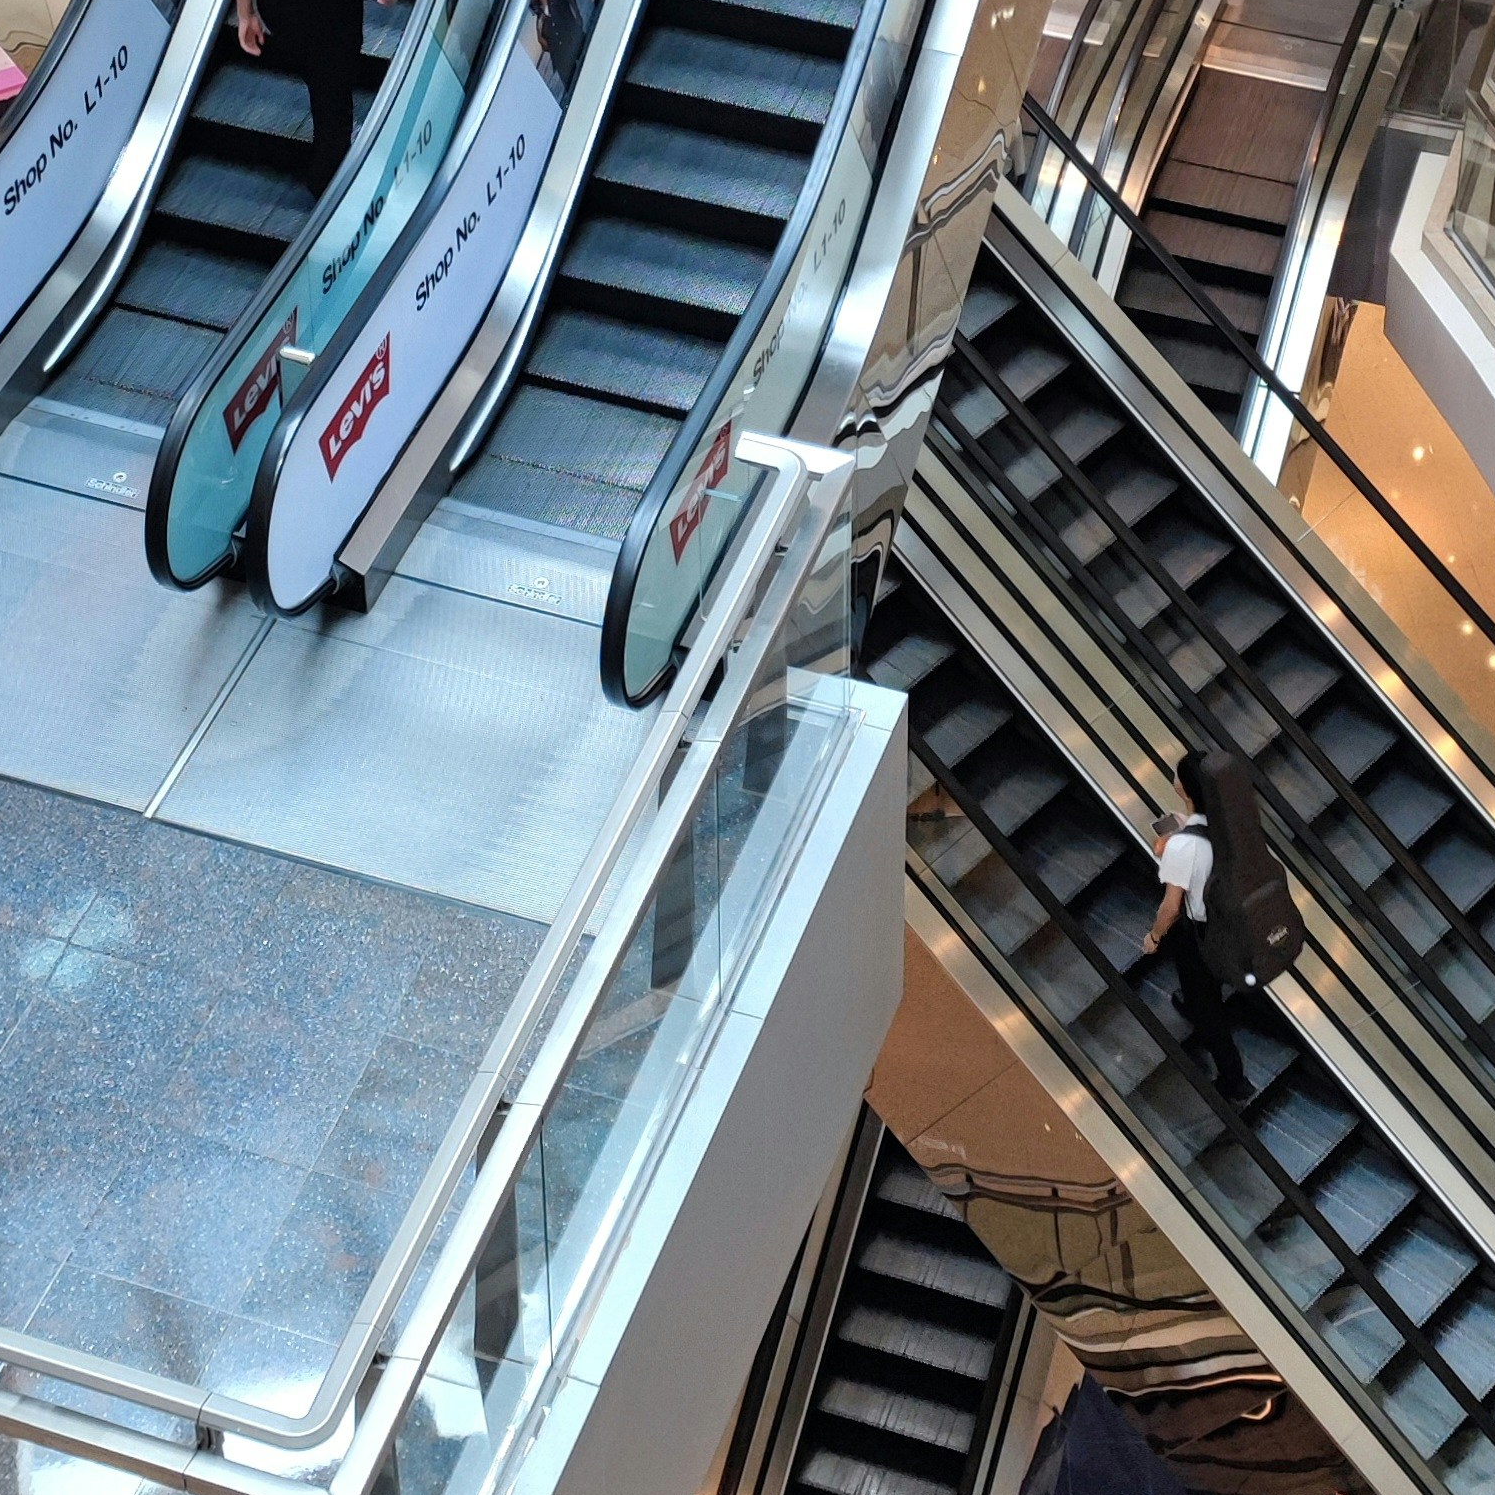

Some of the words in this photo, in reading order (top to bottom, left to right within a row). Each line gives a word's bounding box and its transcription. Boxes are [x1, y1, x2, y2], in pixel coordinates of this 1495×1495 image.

[3, 152, 48, 217] Shop
[49, 122, 79, 161] No.
[83, 43, 130, 117] L1-10
[321, 234, 362, 297] Shop
[391, 118, 434, 188] L1-10
[414, 247, 455, 312] Shop
[456, 214, 482, 253] No.
[484, 131, 527, 208] L1-10
[752, 322, 787, 387] Shop
[812, 196, 847, 275] L1-10
